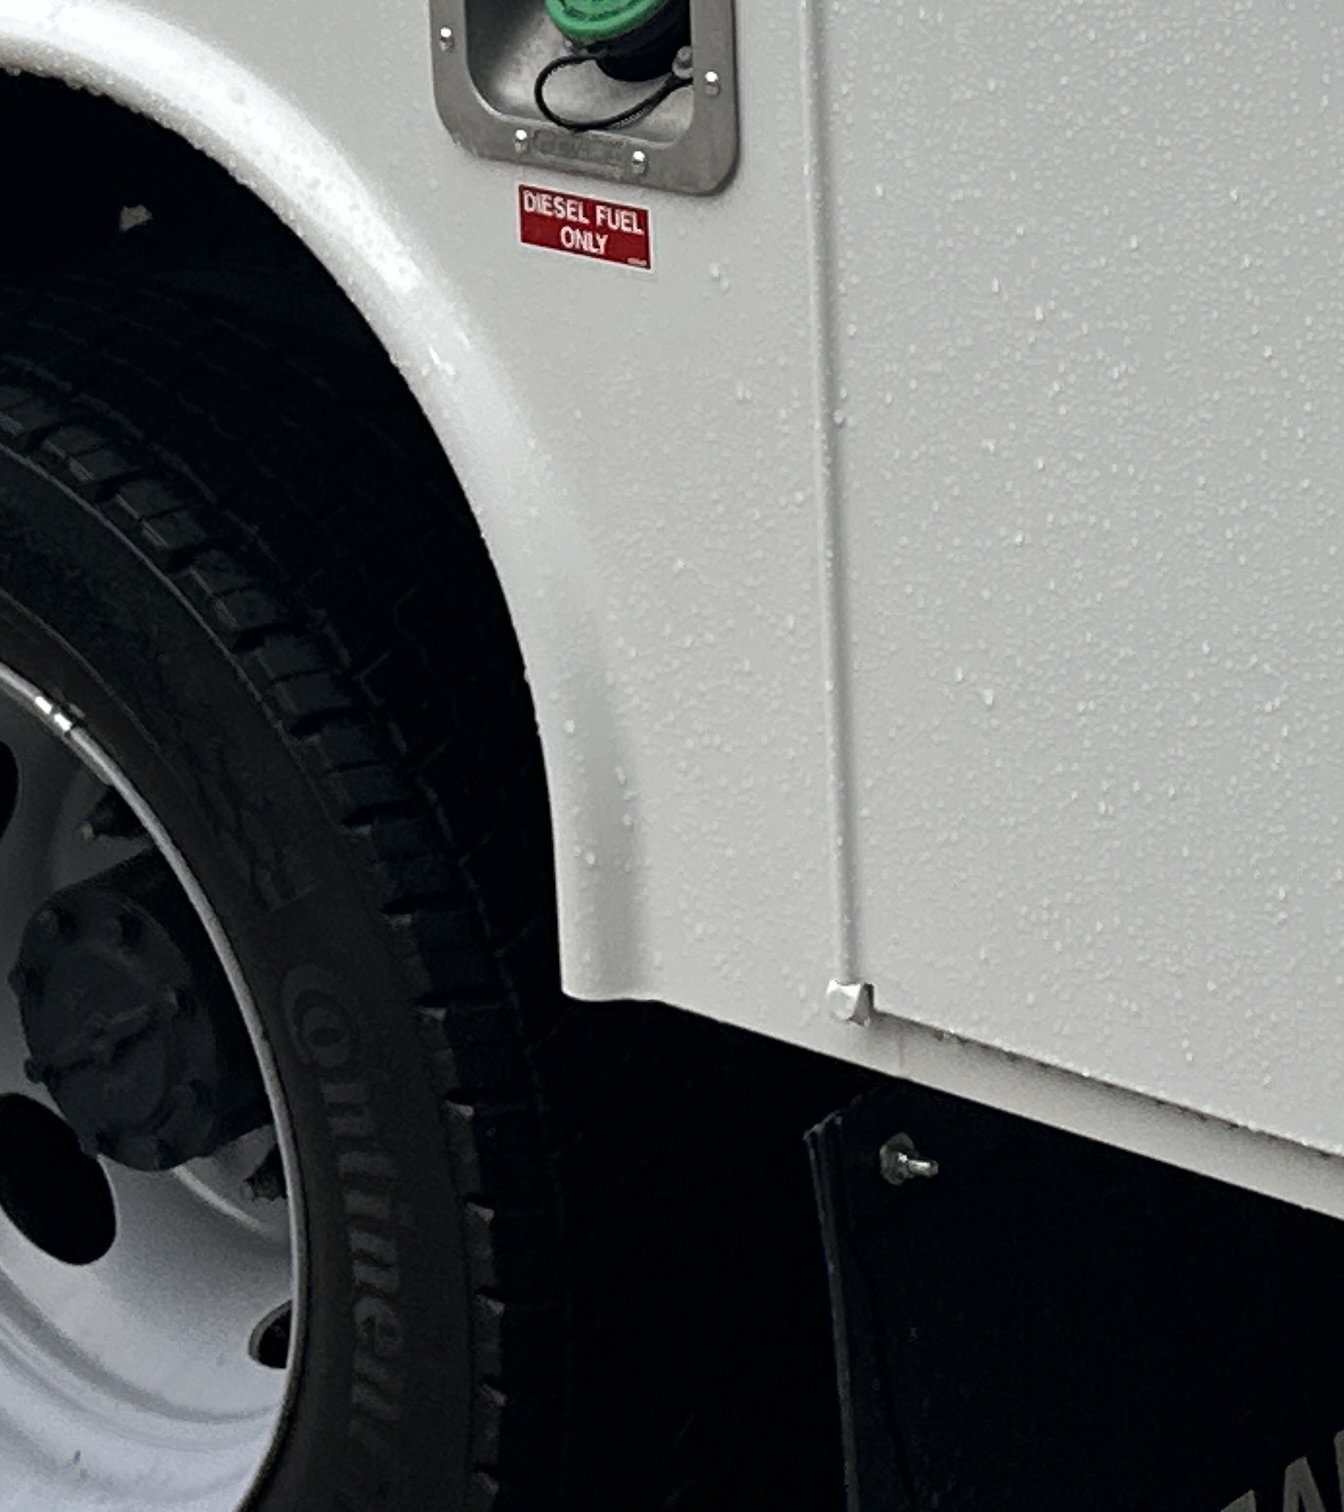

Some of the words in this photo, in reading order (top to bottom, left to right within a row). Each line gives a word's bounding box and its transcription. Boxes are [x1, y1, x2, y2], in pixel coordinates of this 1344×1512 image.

[522, 190, 590, 224] DIESEL
[596, 205, 644, 235] FUEL
[560, 225, 608, 254] ONLY
